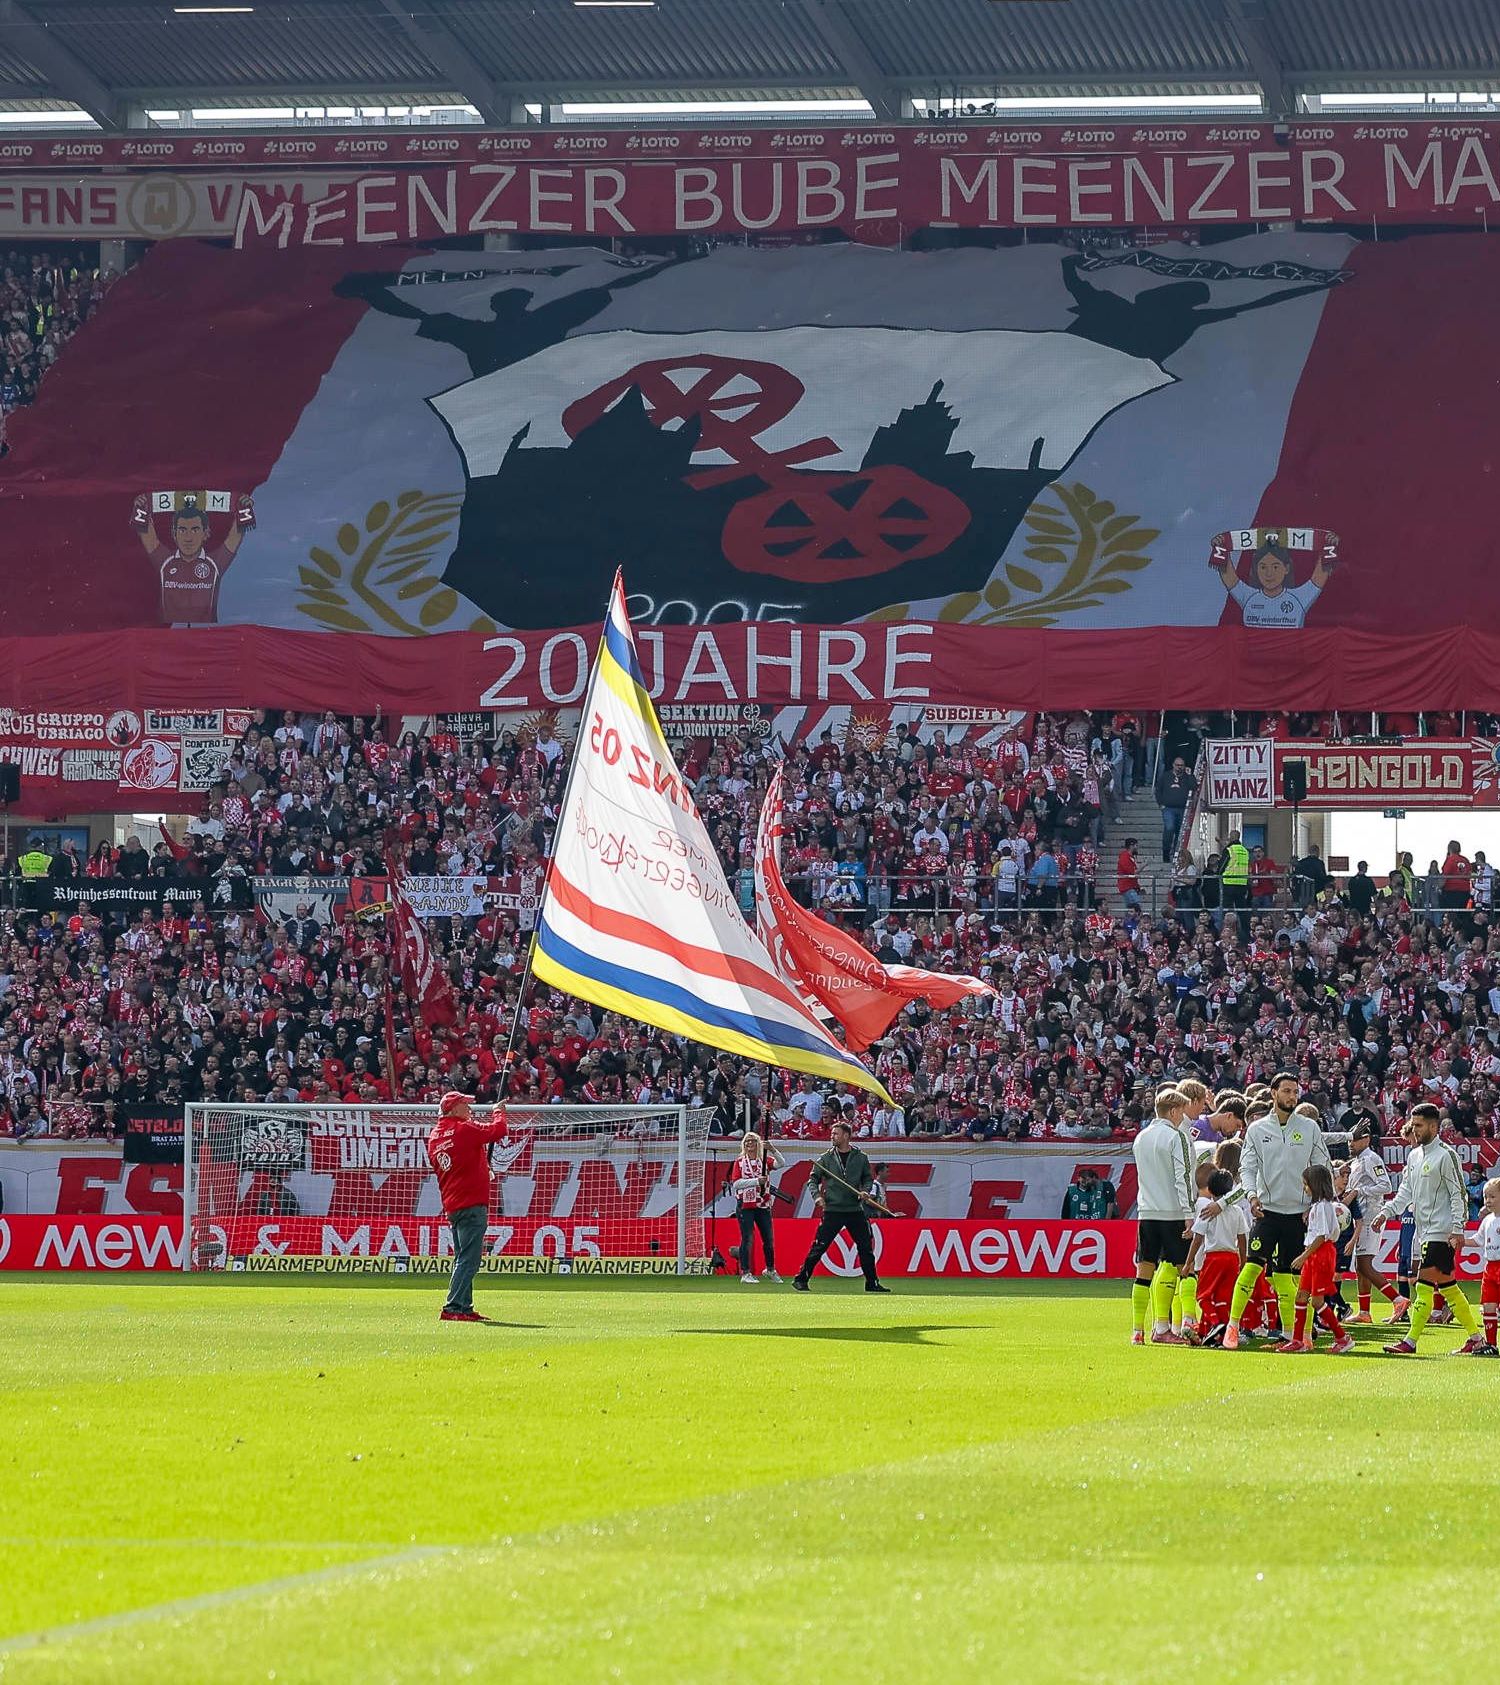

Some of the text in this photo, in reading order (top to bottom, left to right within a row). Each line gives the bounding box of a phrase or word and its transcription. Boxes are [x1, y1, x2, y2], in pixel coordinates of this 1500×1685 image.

[858, 134, 895, 145] LOTTO
[930, 132, 968, 144] LOTTO
[1004, 132, 1041, 143] LOTTO
[1077, 132, 1115, 142] LOTTO
[1149, 130, 1187, 142] LOTTO
[1222, 130, 1260, 141] LOTTO
[1296, 129, 1334, 140] LOTTO
[1370, 128, 1408, 139] LOTTO
[350, 140, 387, 152] LOTTO
[422, 139, 459, 150] LOTTO
[494, 138, 531, 150] LOTTO
[570, 137, 607, 148] LOTTO
[641, 136, 679, 148] LOTTO
[715, 136, 751, 147] LOTTO
[787, 135, 824, 146] LOTTO
[67, 145, 103, 156] LOTTO
[137, 144, 174, 156] LOTTO
[208, 143, 245, 154] LOTTO
[279, 142, 316, 154] LOTTO
[233, 162, 635, 249] MEENZER
[676, 153, 899, 230] BUBE
[941, 150, 1356, 223] MEENZER
[480, 624, 934, 707] 20 JAHRE
[447, 713, 481, 722] CURVA
[660, 704, 740, 721] SEKTION
[37, 712, 104, 726] GRUPPO
[37, 728, 104, 740] UBRIAGO
[185, 740, 220, 748] CONTRO
[1214, 745, 1267, 764] ZITTY
[1280, 755, 1464, 789] HEINGOLD
[1214, 778, 1268, 799] MAINZ
[406, 877, 464, 894] MEIKE
[54, 886, 202, 902] Rheinhessenfront Mainz
[532, 1225, 602, 1258] 05
[907, 1228, 1106, 1274] mewa
[250, 1256, 388, 1272] WÄRMEPUMPEN
